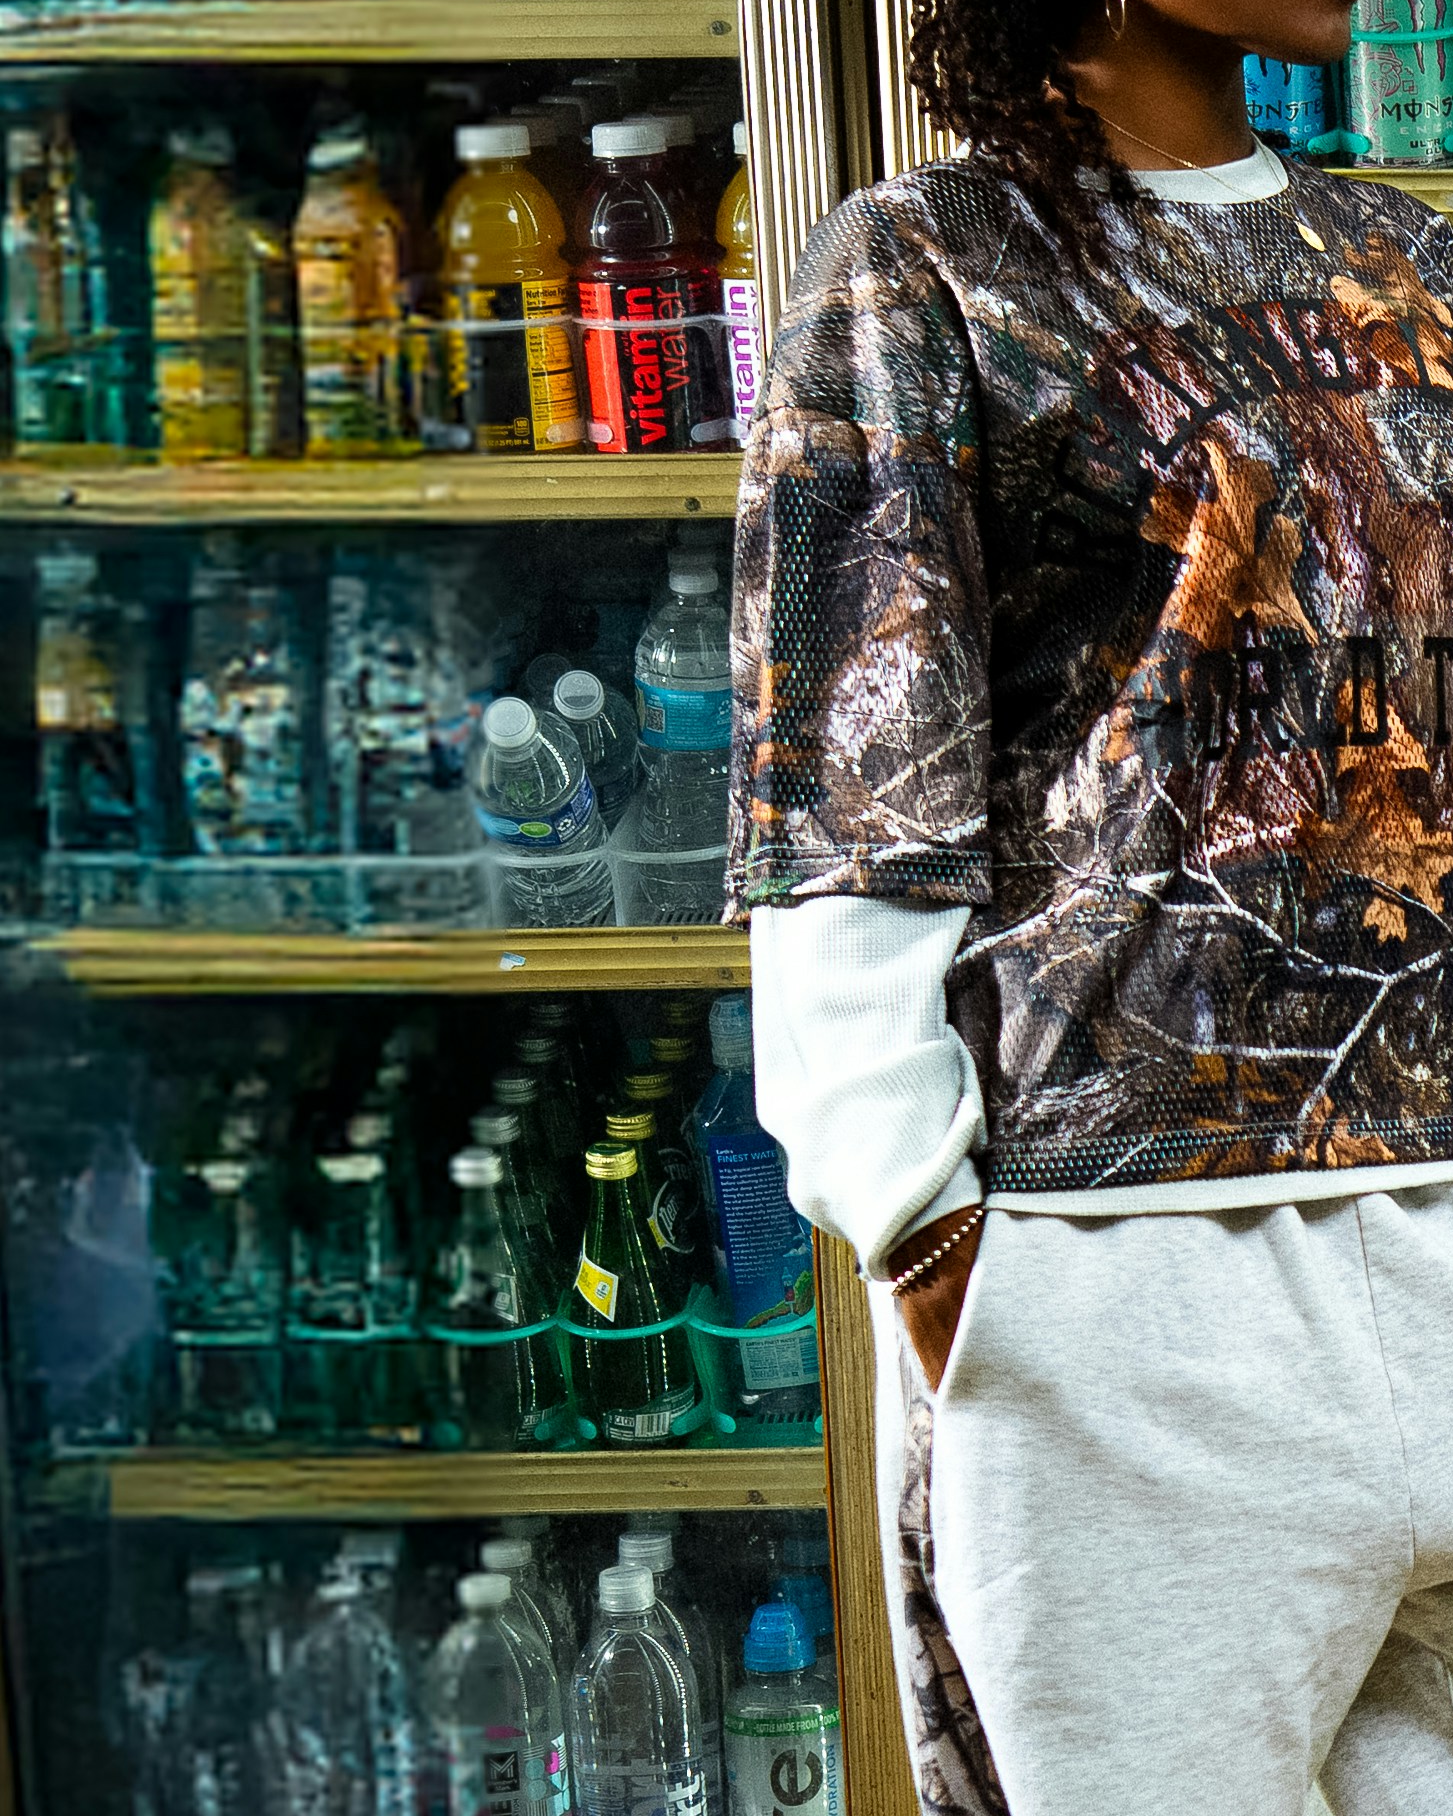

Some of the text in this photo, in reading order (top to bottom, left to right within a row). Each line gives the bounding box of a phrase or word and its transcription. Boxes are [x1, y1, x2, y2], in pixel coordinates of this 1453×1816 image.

[624, 286, 668, 446] vitamin
[655, 285, 691, 392] water
[717, 1152, 749, 1164] FINEST
[795, 1718, 820, 1731] FROM
